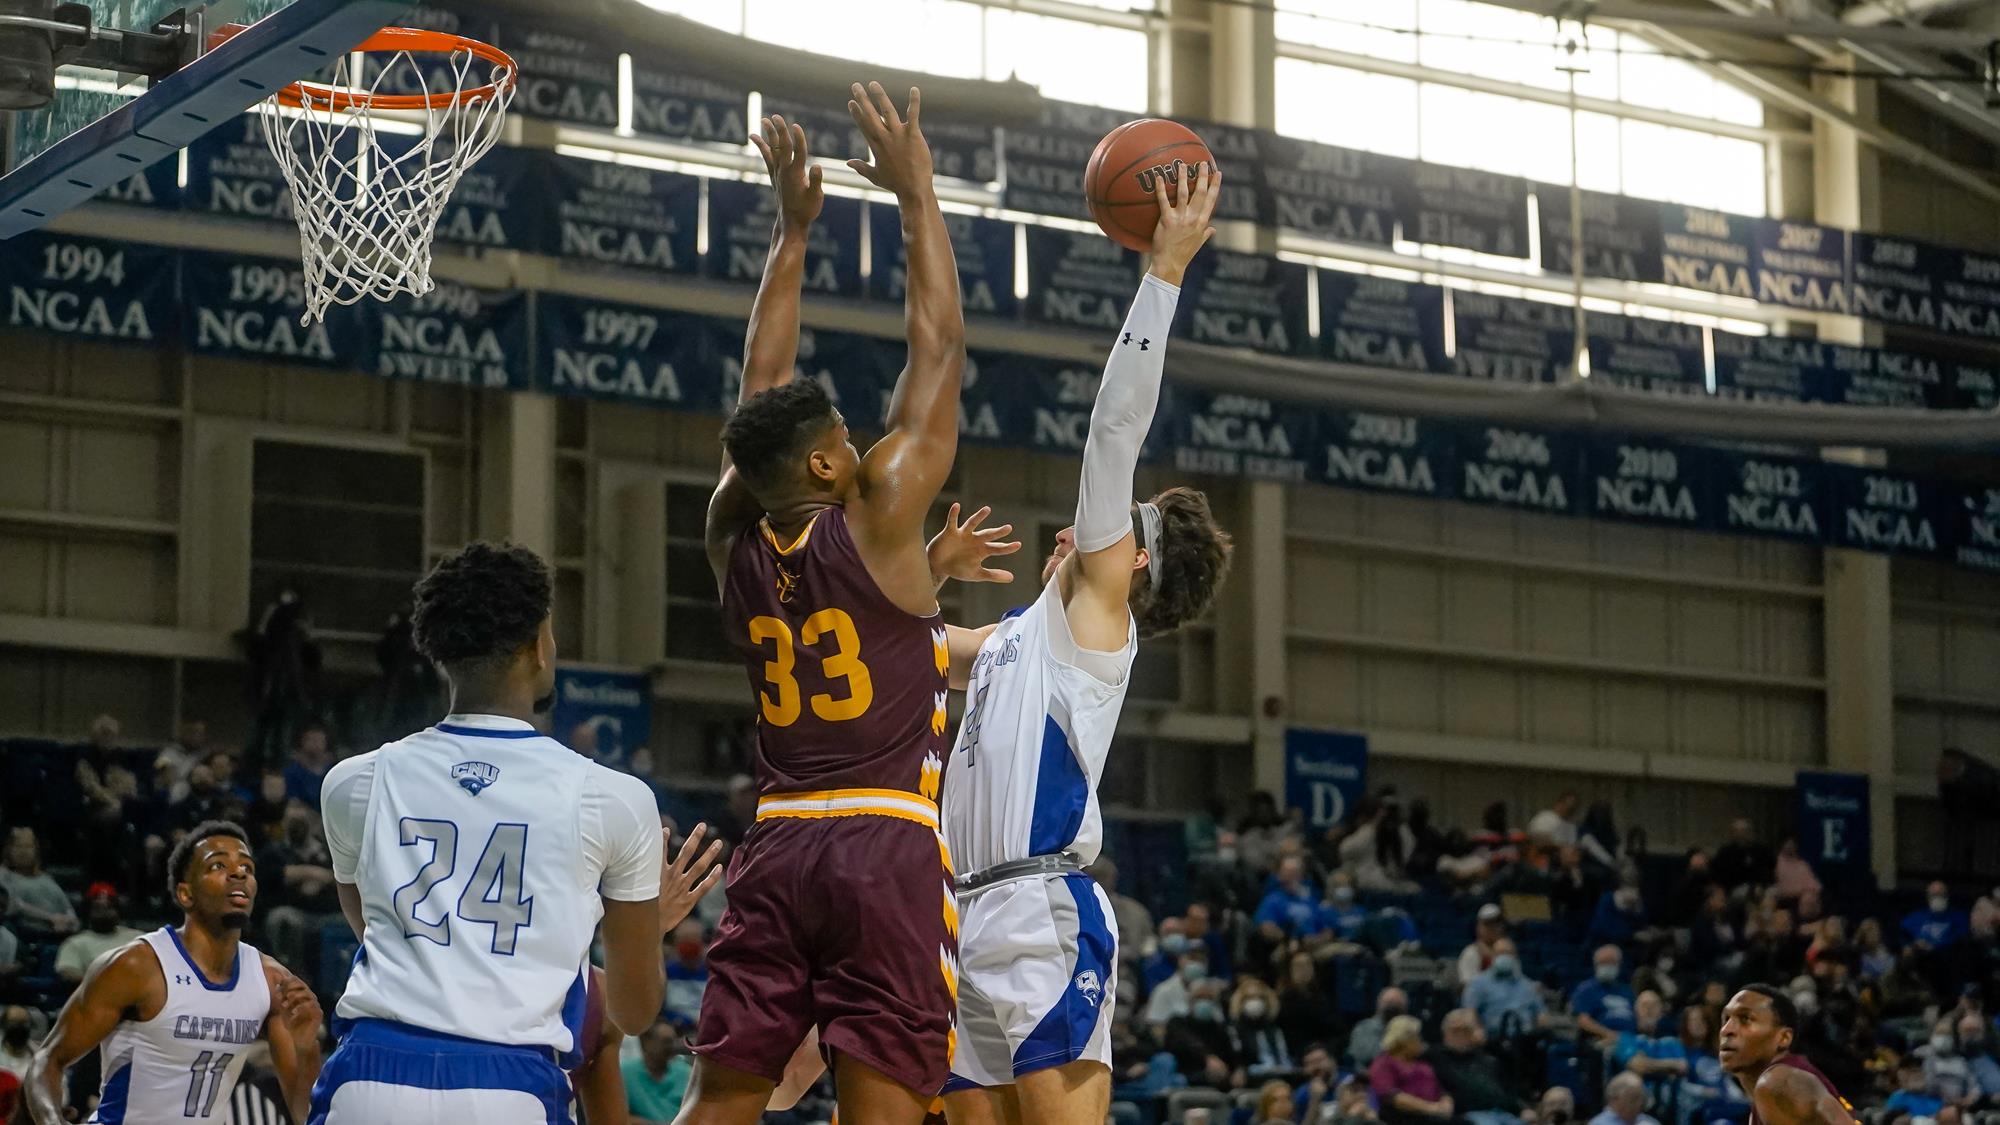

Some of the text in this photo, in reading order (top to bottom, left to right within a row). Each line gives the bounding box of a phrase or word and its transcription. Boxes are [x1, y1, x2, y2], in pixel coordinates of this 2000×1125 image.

[211, 178, 296, 216] NCA
[1276, 196, 1383, 242] NCAA
[42, 243, 126, 288] 1994
[561, 222, 676, 268] NCAA
[730, 246, 838, 290] NA
[1662, 252, 1753, 300] NCAA
[1757, 268, 1849, 312] NCAA
[8, 285, 153, 341] NCAA
[1043, 289, 1122, 327] NCA
[1852, 282, 1937, 325] NCAA
[1940, 301, 2000, 339] NCA
[196, 306, 335, 360] NCAA
[381, 312, 504, 362] NCAA
[583, 308, 659, 350] 1997
[1192, 310, 1290, 351] NCAA
[1333, 328, 1427, 370] NCAA
[552, 347, 682, 401] NCAA
[1034, 407, 1091, 448] NC
[1190, 414, 1291, 457] NCAA
[1326, 444, 1436, 492] NCAA
[1465, 460, 1568, 510] NCAA
[1596, 475, 1697, 521] NCAA
[1727, 493, 1818, 534] NCAA
[1846, 507, 1937, 551] NCAA
[749, 608, 874, 727] 33
[451, 761, 500, 783] CNU
[1311, 781, 1344, 826] D
[1822, 818, 1847, 859] E
[393, 816, 534, 956] 24
[173, 1014, 260, 1045] CAPTAINS
[184, 1050, 235, 1118] 11
